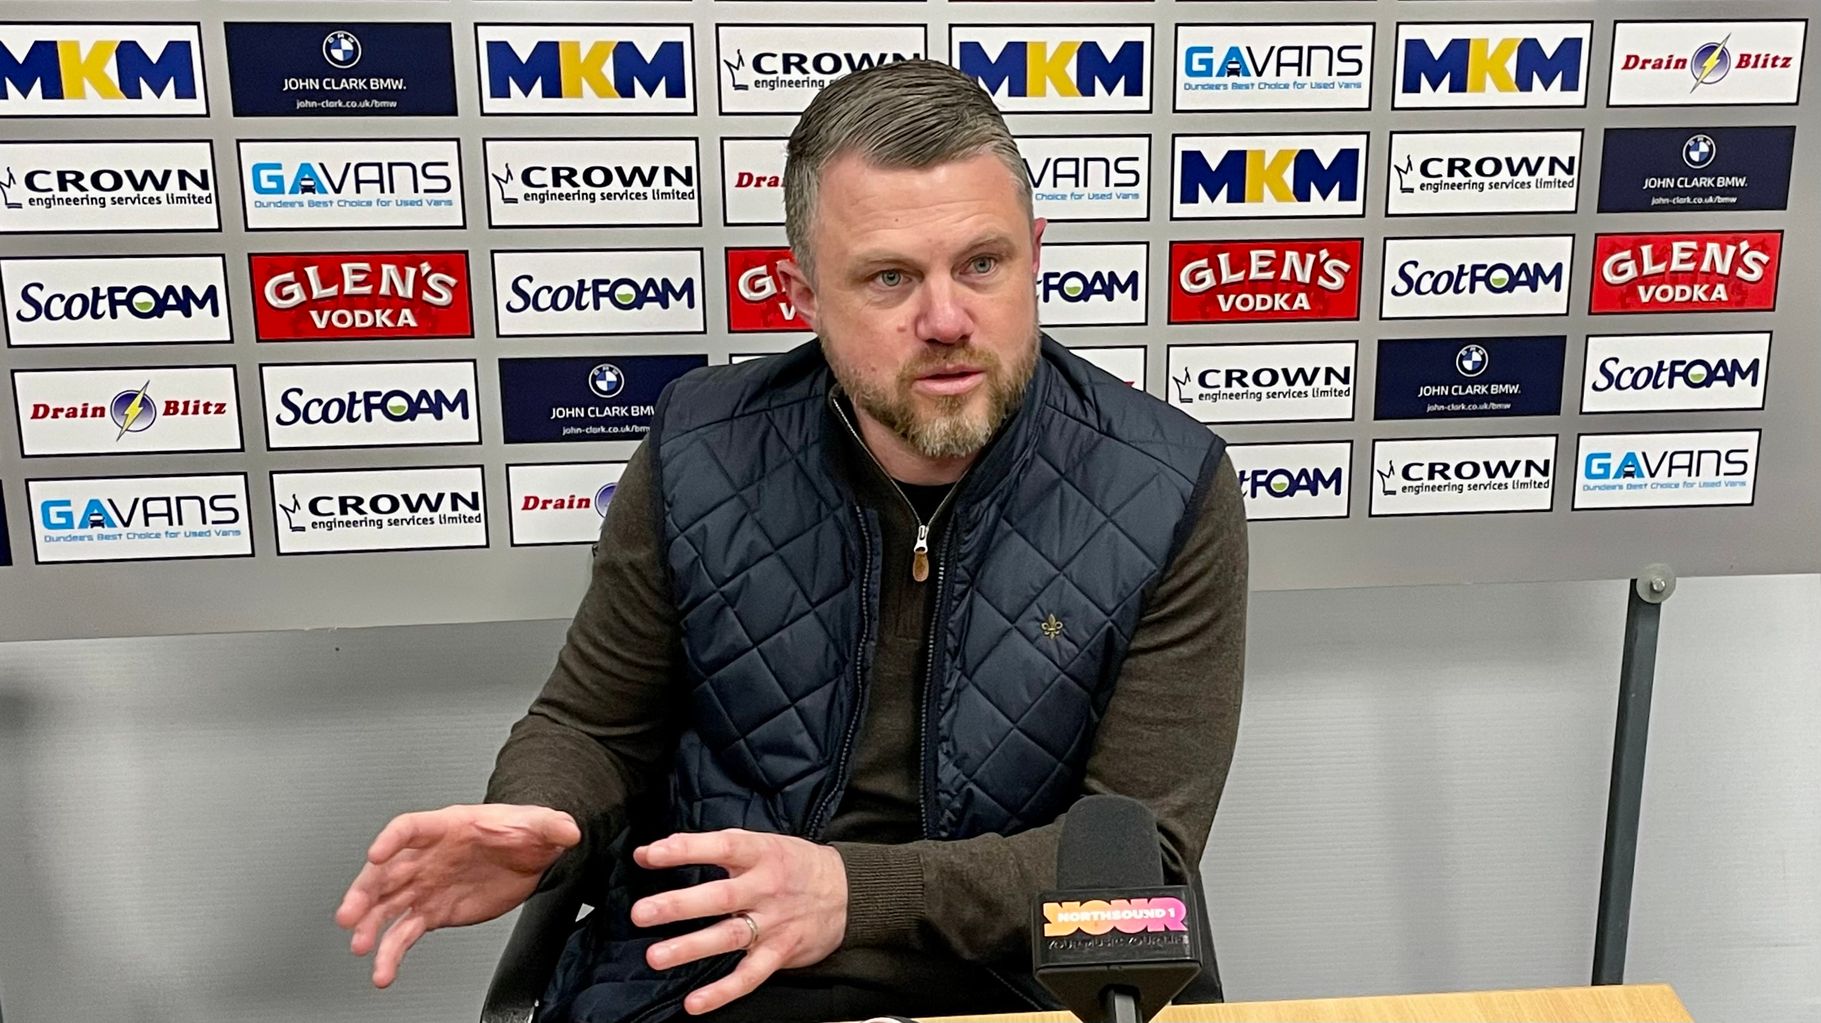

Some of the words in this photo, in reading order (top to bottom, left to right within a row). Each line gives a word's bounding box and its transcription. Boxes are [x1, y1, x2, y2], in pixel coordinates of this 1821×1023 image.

[0, 40, 197, 100] MKM
[486, 40, 687, 99] MKM
[959, 41, 1144, 98] MKM
[1402, 37, 1583, 94] MKM
[1620, 54, 1688, 71] Drain
[1734, 53, 1793, 69] Blitz
[282, 77, 320, 92] JOHN
[322, 77, 368, 90] CLARK
[369, 77, 407, 90] BMW.
[754, 76, 825, 91] engineering
[1231, 81, 1256, 91] Best
[1257, 81, 1291, 90] Choice
[1292, 80, 1308, 90] for
[1309, 81, 1336, 90] Used
[1337, 81, 1362, 89] Vans
[520, 165, 694, 189] CROWN
[1022, 156, 1142, 190] VANS
[1181, 149, 1360, 203] MKM
[1419, 155, 1576, 181] CROWN
[24, 168, 212, 195] CROWN
[734, 170, 787, 189] Dra
[1419, 179, 1485, 194] engineering
[1487, 178, 1532, 191] services
[1535, 177, 1575, 189] limited
[1642, 177, 1675, 190] JOHN
[1676, 176, 1716, 189] CLARK
[1716, 176, 1748, 188] BMW.
[28, 193, 107, 210] engineering
[110, 193, 163, 206] services
[165, 192, 213, 205] limited
[307, 199, 334, 208] Best
[336, 199, 373, 208] Choice
[375, 198, 393, 208] for
[395, 198, 424, 207] Used
[425, 198, 454, 207] Vans
[523, 189, 597, 205] engineering
[599, 189, 648, 201] services
[651, 188, 696, 201] limited
[1034, 192, 1068, 201] Choice
[1069, 191, 1085, 201] for
[1087, 192, 1113, 201] Used
[1115, 192, 1140, 200] Vans
[1178, 249, 1351, 294] GLEN'S
[1601, 240, 1770, 285] GLEN'S
[263, 260, 460, 310] GLEN'S
[1043, 269, 1140, 304] FOAM
[1390, 260, 1564, 297] ScotFOAM
[15, 282, 220, 323] ScotFOAM
[505, 274, 696, 314] ScotFOAM
[1216, 293, 1312, 314] VODKA
[1637, 284, 1729, 305] VODKA
[308, 308, 418, 330] VODKA
[1197, 365, 1351, 391] CROWN
[1591, 356, 1760, 393] ScotFOAM
[1198, 387, 1263, 403] engineering
[1265, 388, 1309, 400] services
[1311, 386, 1351, 398] limited
[1417, 385, 1449, 398] JOHN
[1451, 384, 1489, 396] CLARK
[1490, 383, 1521, 395] BMW.
[30, 402, 106, 420] Drain
[162, 399, 227, 417] Blitz
[275, 387, 470, 427] ScotFOAM
[550, 407, 585, 420] JOHN
[587, 405, 630, 418] CLARK
[631, 405, 655, 416] BM
[562, 424, 650, 436] john-clark.co.uk/bm
[1401, 458, 1551, 483] CROWN
[1239, 467, 1343, 499] tFOAM
[1401, 479, 1464, 496] engineering
[1465, 478, 1509, 492] services
[1508, 476, 1550, 490] limited
[1625, 482, 1649, 491] Best
[1650, 482, 1681, 490] Choice
[1682, 480, 1697, 489] for
[308, 491, 482, 517] CROWN
[521, 494, 591, 511] Drain
[311, 513, 384, 532] engineering
[385, 512, 435, 527] services
[436, 510, 482, 525] limited
[96, 533, 123, 541] Best
[126, 531, 162, 540] Choice
[164, 530, 181, 539] for
[183, 529, 212, 538] Used
[214, 529, 242, 537] Vans
[1057, 909, 1165, 922] NORTHSOUND
[1167, 907, 1176, 918] 1
